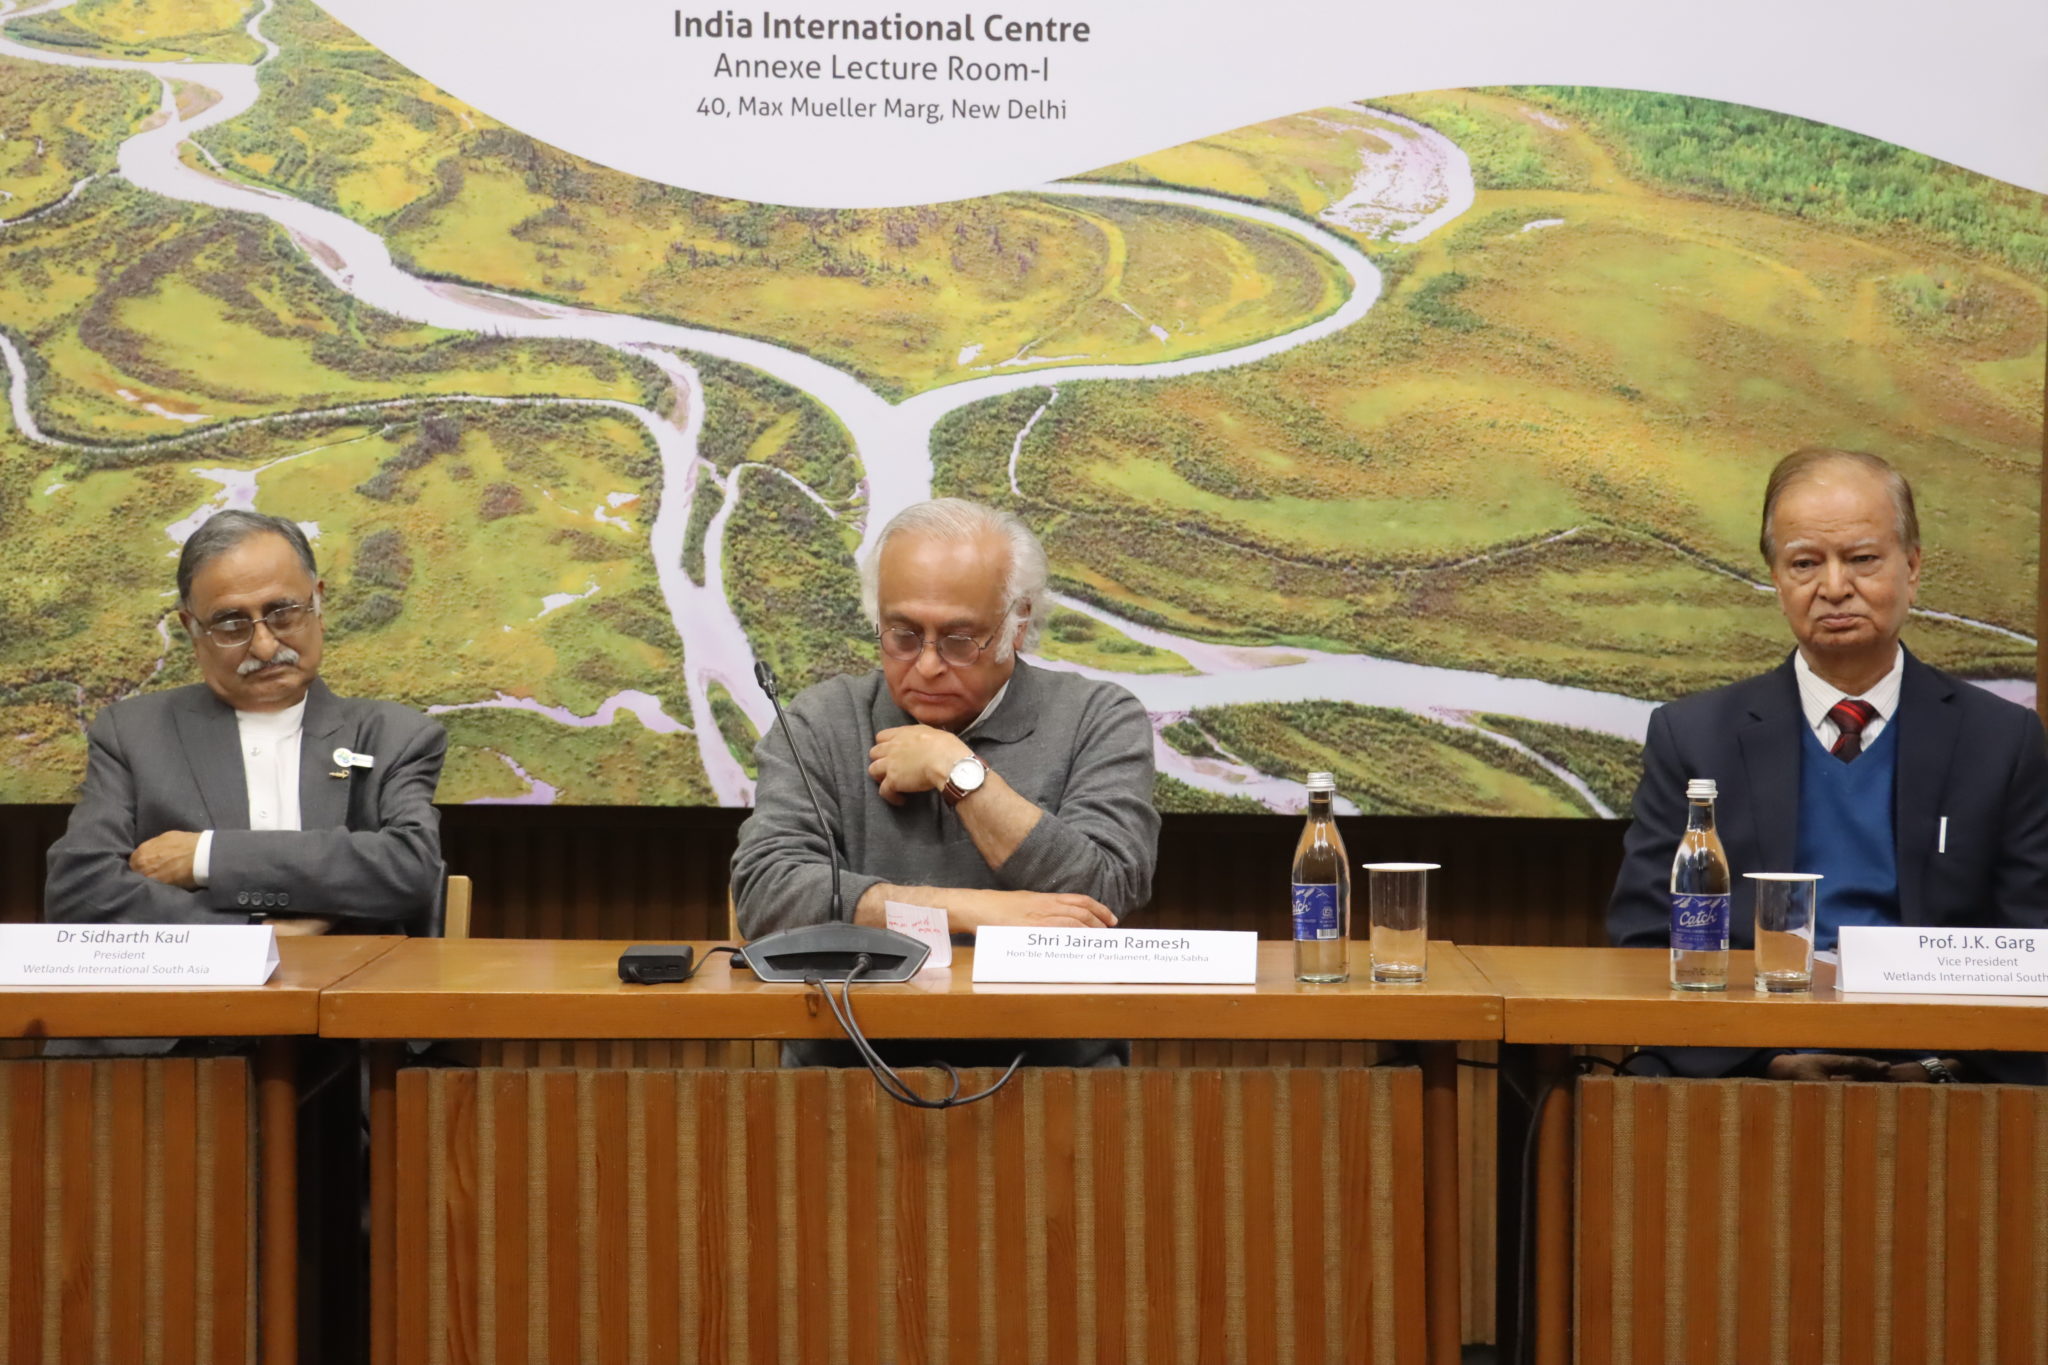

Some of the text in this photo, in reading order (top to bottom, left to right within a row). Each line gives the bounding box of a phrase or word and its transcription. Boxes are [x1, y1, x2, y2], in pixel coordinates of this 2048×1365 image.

[674, 10, 1090, 42] India International Centre
[713, 53, 1049, 81] Annexe Lecture Room-I
[696, 96, 1067, 124] 40, Max Mueller Marg, New Delhi
[1680, 909, 1717, 927] Catch
[57, 930, 189, 944] Dr Sidharth Kaul
[1027, 934, 1190, 949] Shri Jairam Ramesh
[1919, 935, 2035, 952] Prof. J.K. Garg
[94, 951, 145, 959] President
[1045, 951, 1084, 959] Member
[1154, 954, 1178, 962] Rajya
[1181, 954, 1208, 962] Sabha
[1938, 957, 2018, 966] Vice President
[24, 965, 209, 974] Wetlands International South Asia
[1884, 972, 1936, 981] Wetlands
[1940, 972, 2012, 982] International
